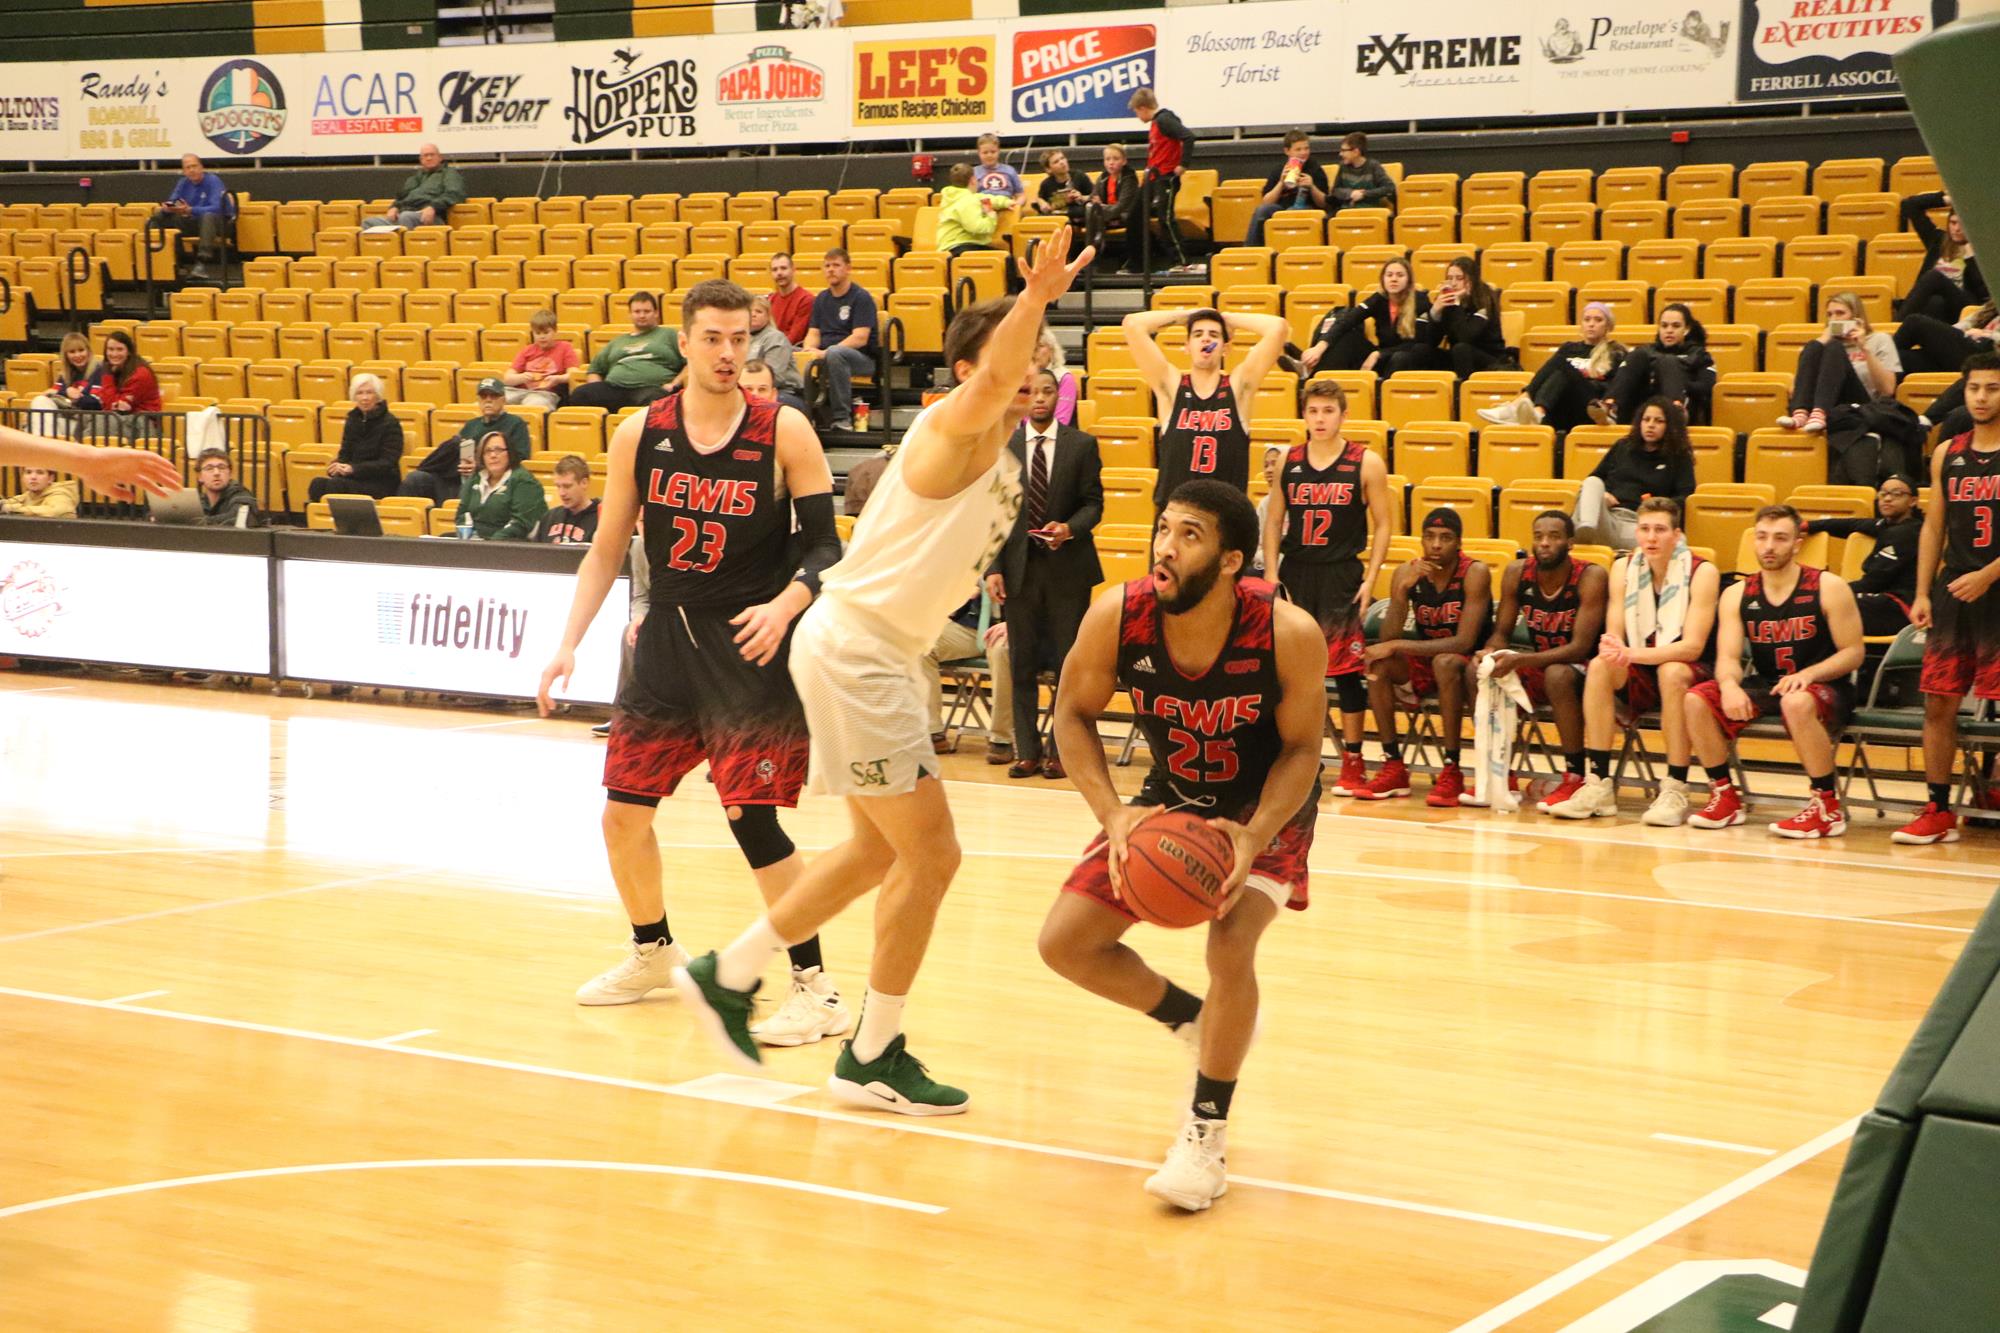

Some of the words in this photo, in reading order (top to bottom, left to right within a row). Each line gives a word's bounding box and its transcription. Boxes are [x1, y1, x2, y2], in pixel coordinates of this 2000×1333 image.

[1791, 0, 1893, 18] REALTY
[1187, 32, 1257, 53] Blossom
[1262, 26, 1322, 53] Basket
[1586, 17, 1679, 50] Penelope's
[1609, 37, 1675, 52] Restaurant
[1760, 16, 1924, 47] EXECUTIVES
[756, 47, 784, 58] PIZZA
[1020, 30, 1103, 79] PRICE
[1356, 33, 1521, 76] EXTREME
[80, 70, 169, 104] Randy's
[719, 65, 762, 101] PAPA
[859, 46, 988, 99] LEE'S
[1221, 62, 1281, 87] Florist
[1400, 72, 1520, 88] Accessories
[1751, 74, 1824, 92] FERRELL
[313, 72, 418, 117] ACAR
[438, 70, 523, 125] KEY
[564, 59, 698, 144] HOPPERS
[1016, 58, 1151, 119] CHOPPER
[475, 99, 552, 123] SPORT
[724, 109, 754, 120] Better
[858, 102, 899, 119] Famous
[902, 100, 938, 120] Recipe
[941, 98, 986, 116] Chicken
[128, 128, 173, 148] GRILL
[313, 120, 344, 134] REAL
[346, 119, 395, 133] ESTATE
[640, 115, 697, 138] PUB
[739, 122, 768, 133] Better
[1176, 408, 1232, 433] LEWIS
[1190, 436, 1217, 474] 13
[648, 468, 758, 517] LEWIS
[1287, 482, 1354, 506] LEWIS
[1302, 509, 1333, 546] 12
[1973, 505, 1993, 547] 3
[667, 515, 728, 573] 23
[409, 593, 529, 658] fidelity
[1747, 615, 1817, 643] LEWIS
[1775, 646, 1796, 678] 5
[1132, 687, 1262, 737] LEWIS
[1168, 727, 1239, 783] 25
[850, 758, 889, 787] S&T
